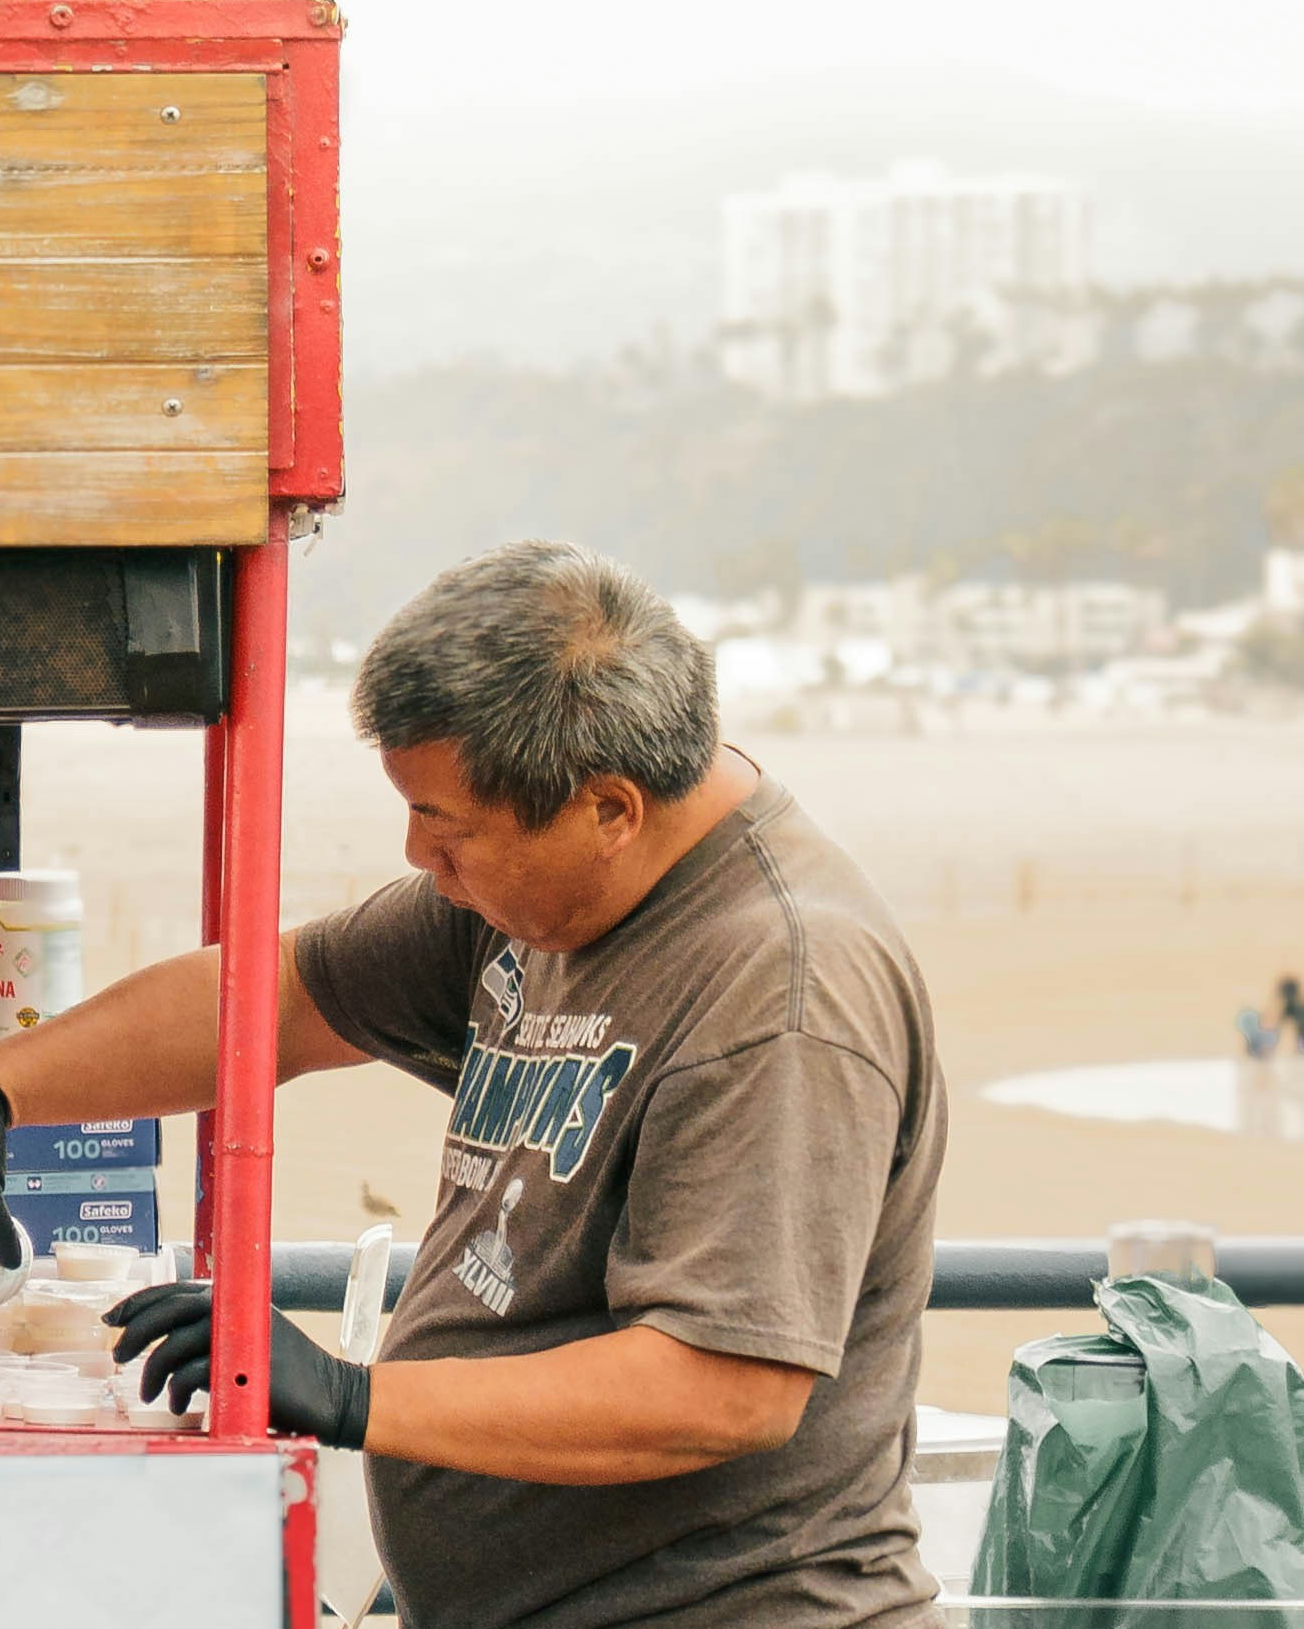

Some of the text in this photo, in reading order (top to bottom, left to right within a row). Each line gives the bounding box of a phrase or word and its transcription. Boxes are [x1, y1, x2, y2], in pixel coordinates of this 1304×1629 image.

[53, 1140, 101, 1159] 100
[101, 1138, 134, 1147] GLOVES
[84, 1205, 129, 1217] Safeko
[100, 1225, 133, 1234] GLOVES
